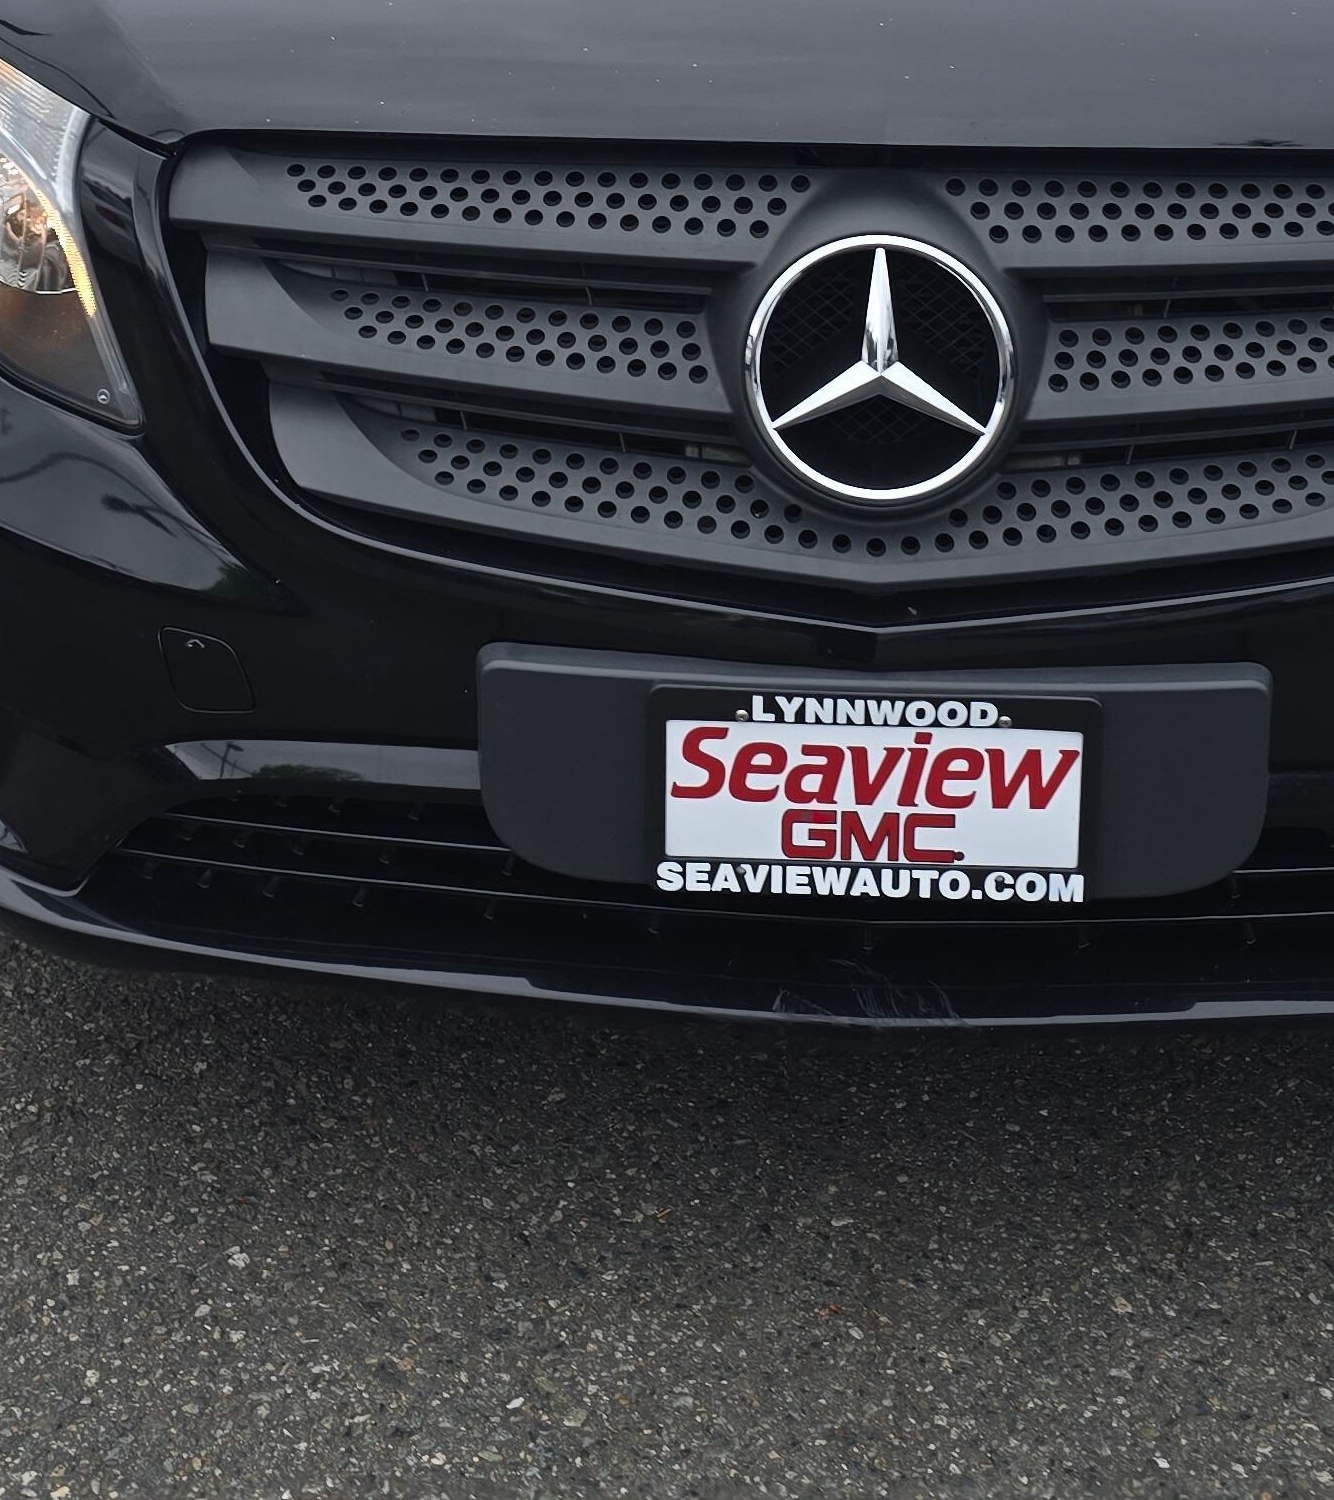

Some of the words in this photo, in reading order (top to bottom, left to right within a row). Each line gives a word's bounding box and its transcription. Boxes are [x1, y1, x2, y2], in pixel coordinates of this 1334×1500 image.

[751, 695, 999, 728] LYNNWOOD
[670, 726, 1080, 810] Seaview
[781, 808, 957, 863] GMC
[656, 862, 1084, 903] SEAVIEWAUTO.COM
